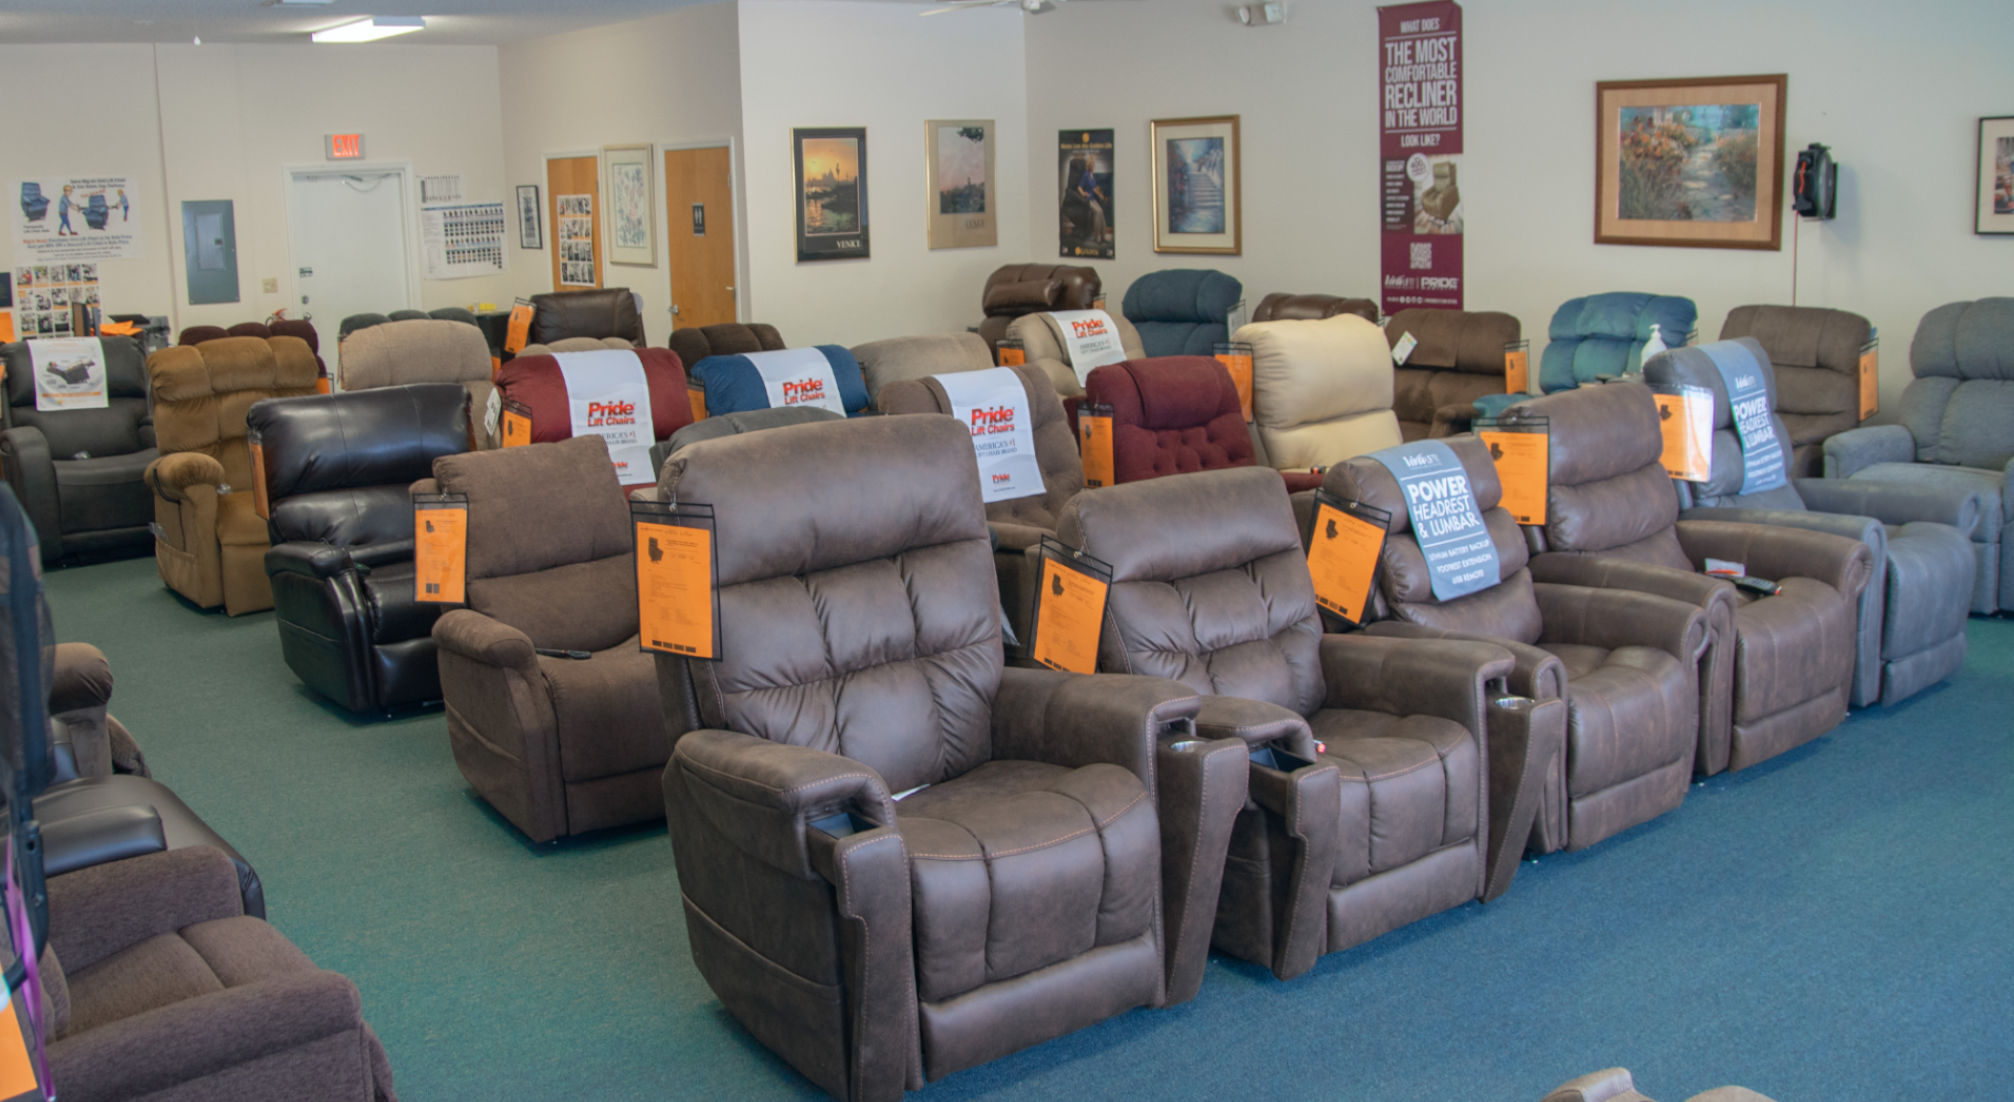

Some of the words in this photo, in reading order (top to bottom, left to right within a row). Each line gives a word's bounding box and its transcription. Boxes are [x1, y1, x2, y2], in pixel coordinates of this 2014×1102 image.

[1401, 20, 1419, 33] WHAT
[1422, 18, 1440, 31] DOES
[1385, 41, 1412, 65] THE
[1415, 37, 1457, 63] MOST
[1385, 61, 1457, 83] COMFORTABLE
[1385, 80, 1457, 109] RECLINER
[1385, 110, 1396, 128] IN
[1398, 109, 1417, 127] THE
[1420, 107, 1458, 126] WORLD
[333, 134, 360, 157] EXIT
[1401, 135, 1419, 147] LOOK
[1420, 133, 1440, 146] LIKE?
[1421, 277, 1457, 287] PRIDE
[1072, 318, 1104, 331] Pride
[782, 378, 823, 396] Pride
[784, 395, 799, 405] Lift
[800, 391, 826, 402] Chairs
[588, 400, 634, 417] Pride
[971, 405, 1014, 426] Pride
[1734, 396, 1767, 421] POWER
[587, 417, 603, 427] Lift
[606, 415, 636, 425] Chairs
[971, 425, 986, 436] Lift
[987, 423, 1015, 434] Chairs
[1407, 475, 1469, 504] POWER
[1412, 495, 1472, 522] HEADREST
[1418, 523, 1429, 540] &
[1430, 512, 1480, 537] LUMBAR
[1462, 553, 1493, 568] EXTENSION
